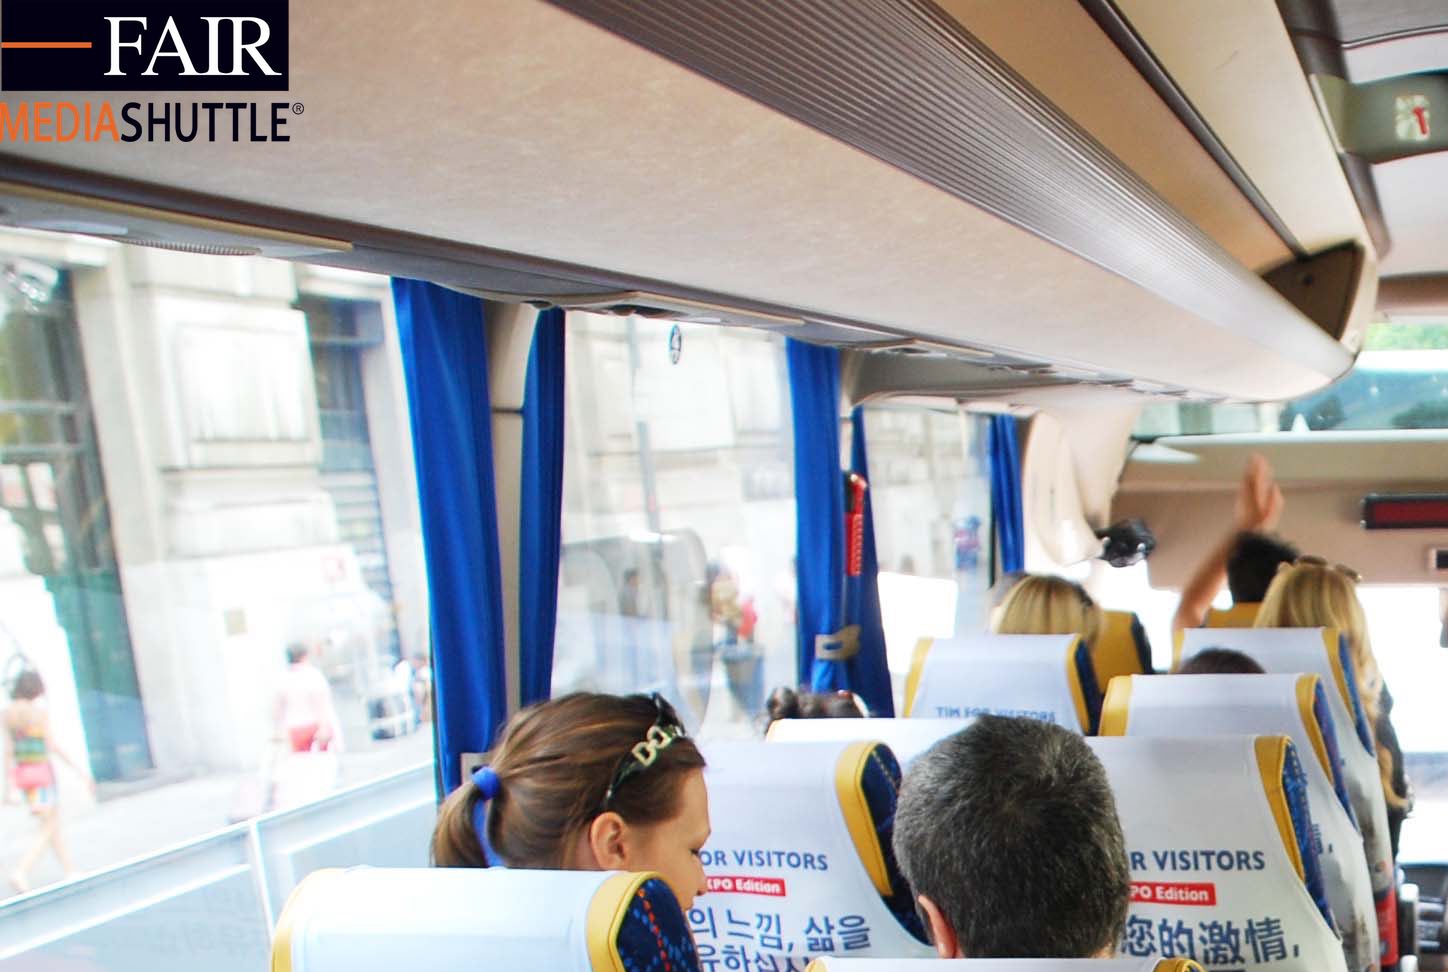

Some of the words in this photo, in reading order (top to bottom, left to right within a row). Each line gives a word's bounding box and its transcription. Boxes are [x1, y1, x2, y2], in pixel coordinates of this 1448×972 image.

[699, 850, 727, 866] OR
[732, 849, 829, 871] VISITORS
[1152, 850, 1265, 871] VISITORS
[734, 877, 782, 894] Edition
[1155, 885, 1209, 902] Edition
[803, 914, 872, 953] 삶을
